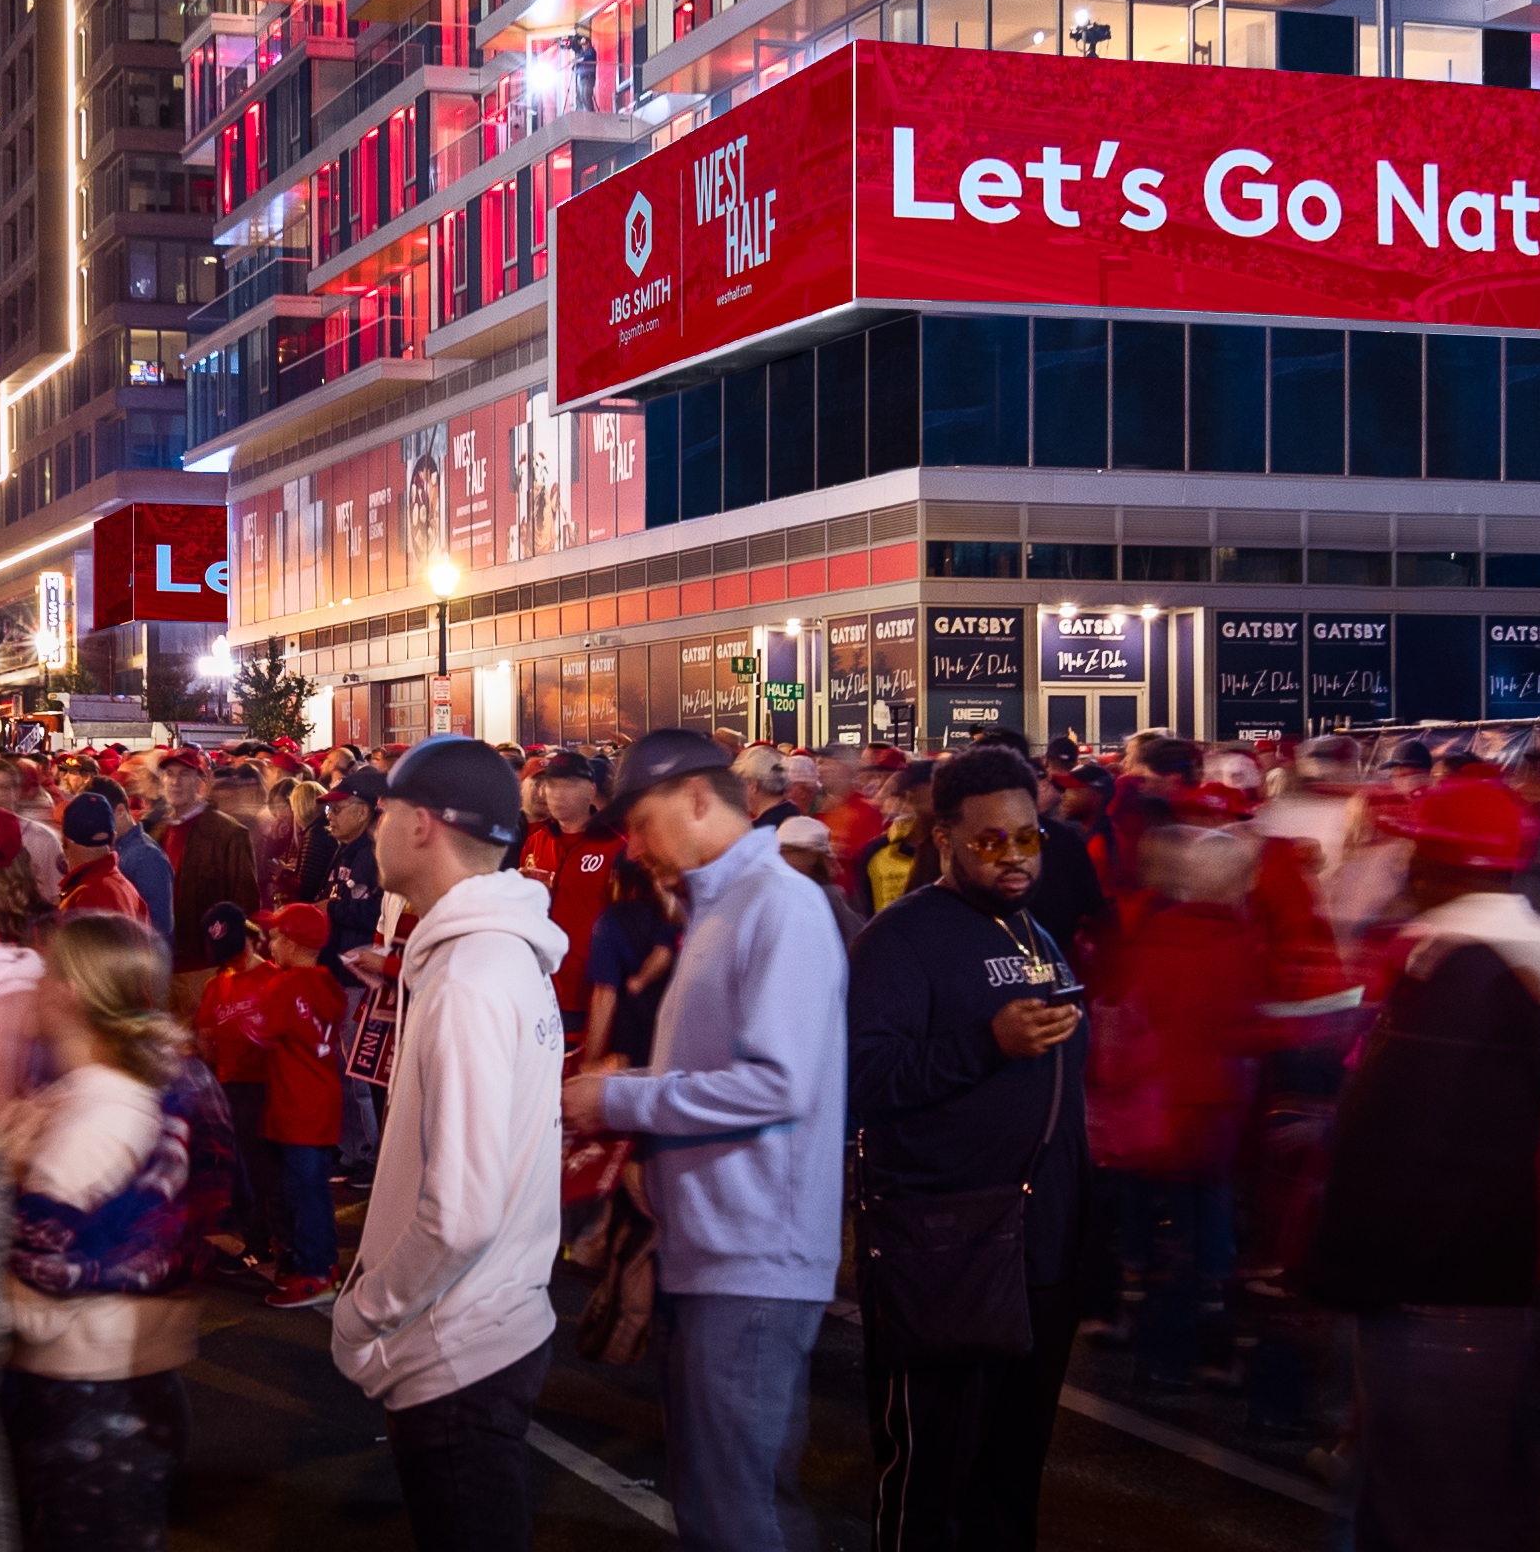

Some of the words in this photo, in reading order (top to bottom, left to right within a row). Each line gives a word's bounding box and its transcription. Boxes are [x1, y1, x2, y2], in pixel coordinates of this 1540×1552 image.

[694, 134, 748, 226] WEST
[1204, 149, 1342, 242] Go
[726, 189, 776, 278] HALF
[609, 294, 631, 325] JBG
[634, 275, 671, 316] SMITH
[717, 284, 752, 306] westhalf.com
[618, 317, 660, 347] jbgsmith.com
[592, 413, 620, 453] WEST
[453, 429, 475, 469] WEST
[610, 439, 635, 484] HALF
[466, 458, 487, 496] HALF
[45, 578, 60, 662] MISSIN
[876, 618, 915, 639] GATSBY
[934, 616, 1016, 635] GATSBY
[1058, 619, 1123, 635] GATSBY
[1222, 622, 1298, 639] GATSBY
[1313, 623, 1386, 639] GATSBY
[831, 624, 867, 644] GATSBY
[682, 646, 711, 663] GATSBY
[716, 640, 748, 659] GATSBY
[591, 657, 616, 673] GATSBY
[766, 683, 794, 697] HALF
[773, 698, 795, 711] 1200
[952, 708, 999, 721] KNEAD
[984, 956, 1026, 987] JUS
[357, 1018, 385, 1069] FINIS
